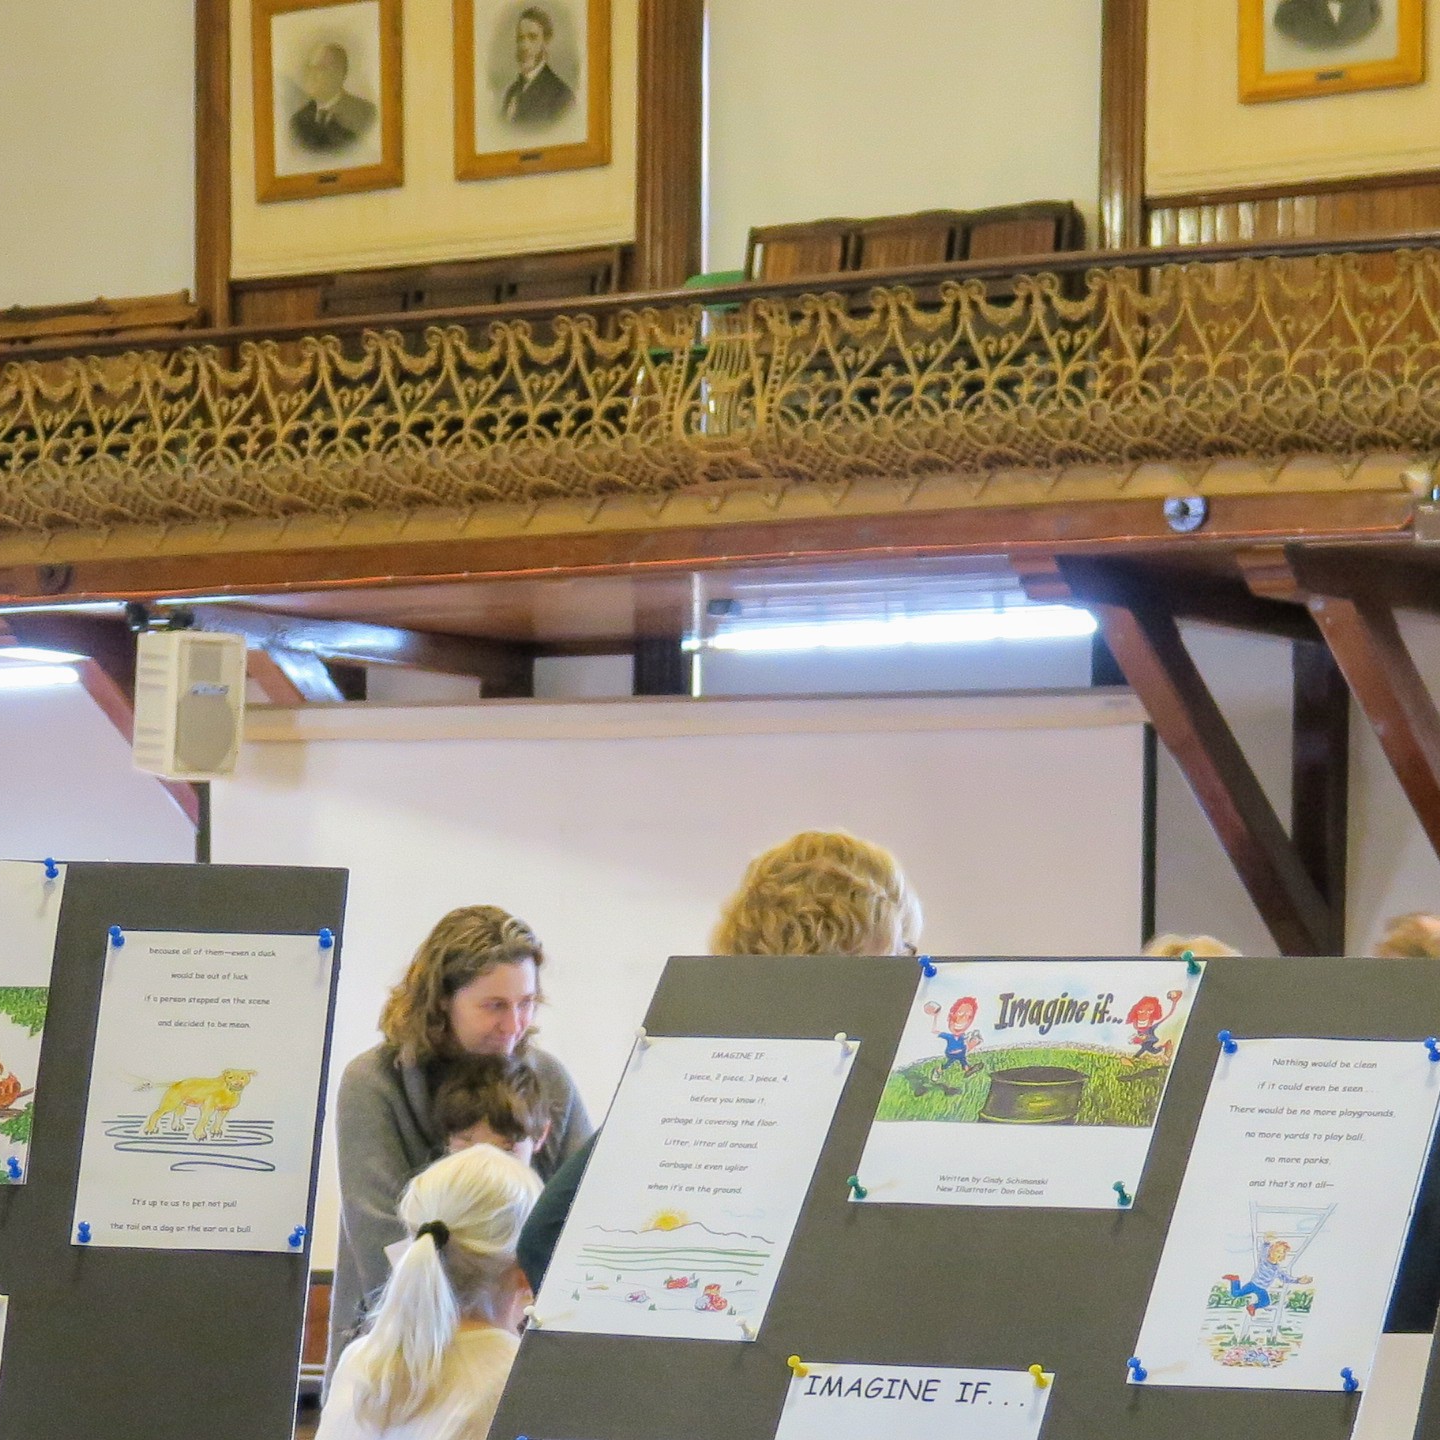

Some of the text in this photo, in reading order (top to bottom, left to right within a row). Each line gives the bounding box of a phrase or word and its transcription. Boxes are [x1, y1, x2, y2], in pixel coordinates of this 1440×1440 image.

[994, 992, 1089, 1035] Imagine
[1272, 1058, 1309, 1068] Nothing
[1353, 1060, 1377, 1068] clean
[970, 1176, 982, 1184] by
[983, 1176, 1004, 1184] Cindy
[1001, 1187, 1016, 1195] Don
[804, 1376, 940, 1402] IMAGINE
